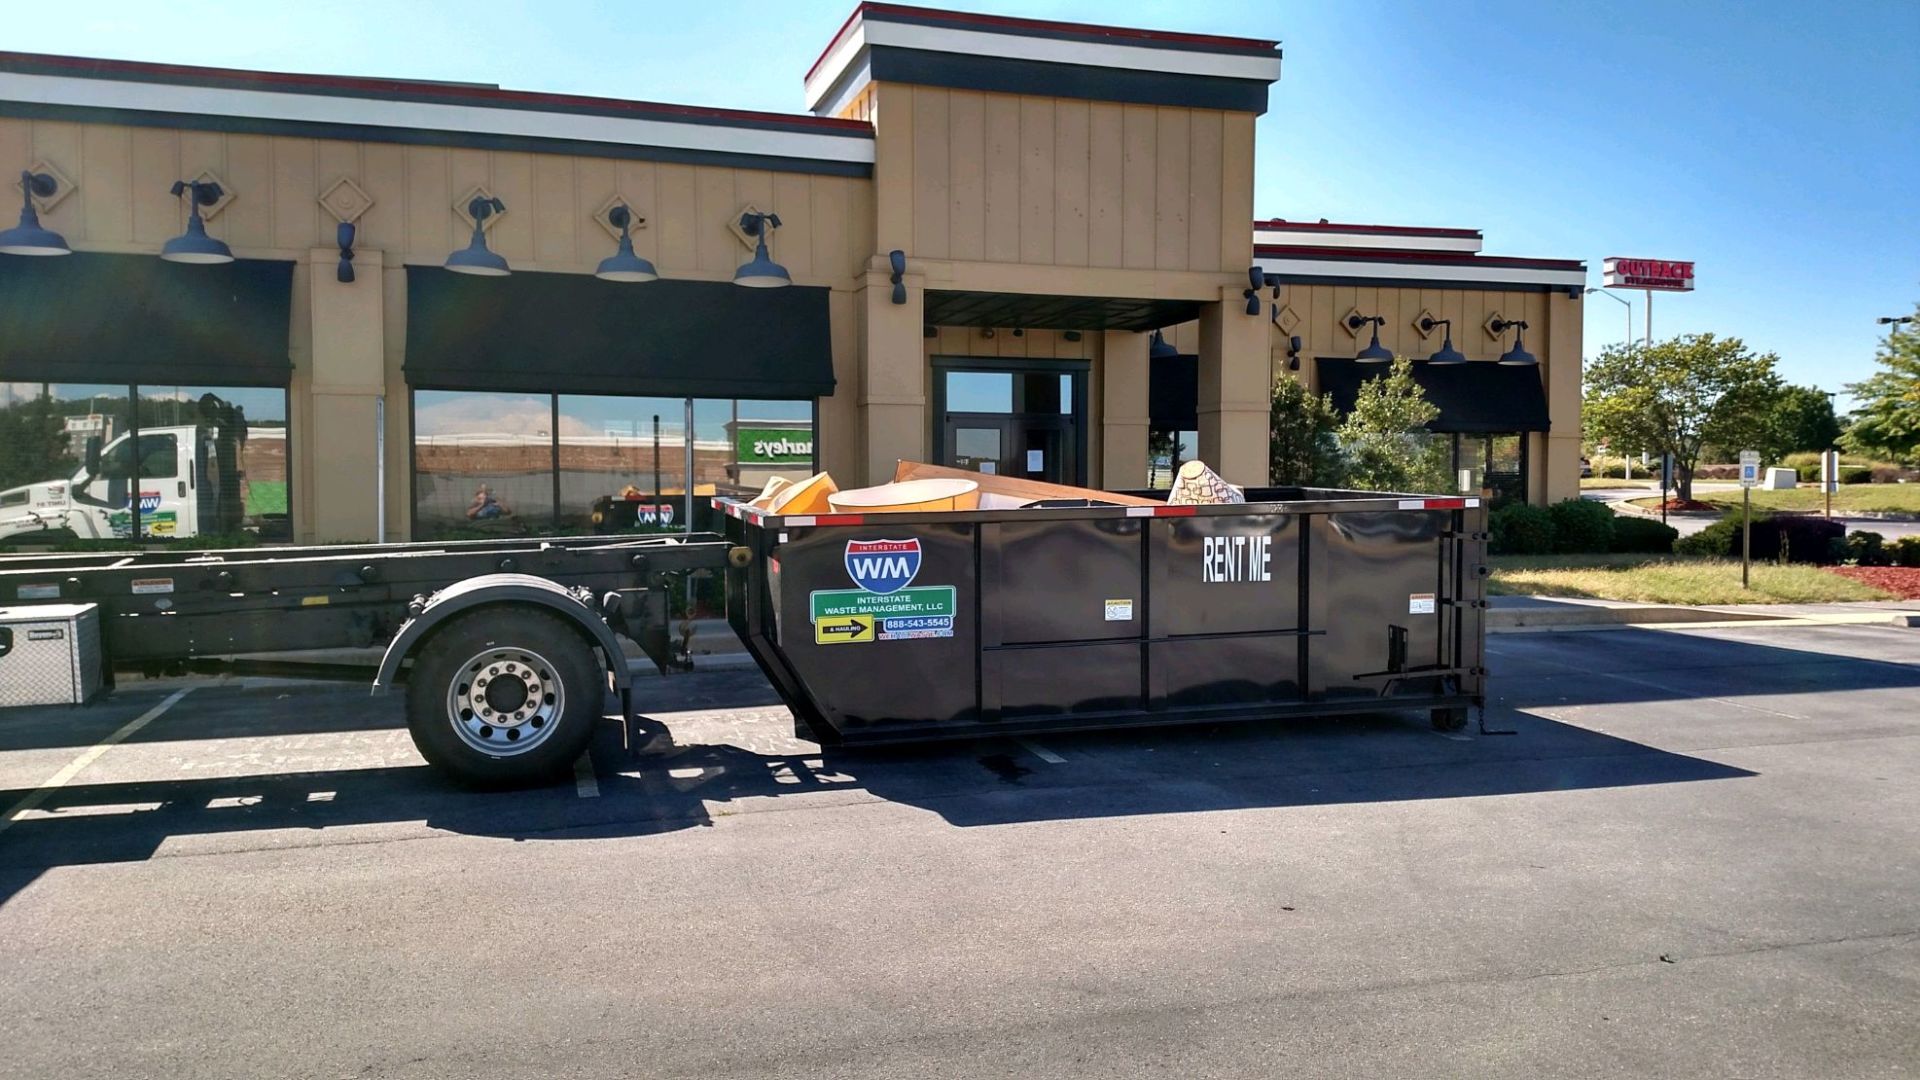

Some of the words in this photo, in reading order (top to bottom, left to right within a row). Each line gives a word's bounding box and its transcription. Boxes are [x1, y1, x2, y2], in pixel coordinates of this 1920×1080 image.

[1616, 260, 1694, 279] OUTBACK
[859, 543, 907, 551] INTERSTATE
[1203, 536, 1246, 582] RENT
[1249, 535, 1272, 582] ME
[853, 556, 911, 580] WM
[857, 594, 911, 605] INTERSTATE
[824, 606, 857, 615] WASTE
[858, 603, 924, 614] MANAGEMENT,
[926, 602, 944, 611] LLC
[887, 617, 950, 629] 888-543-5545
